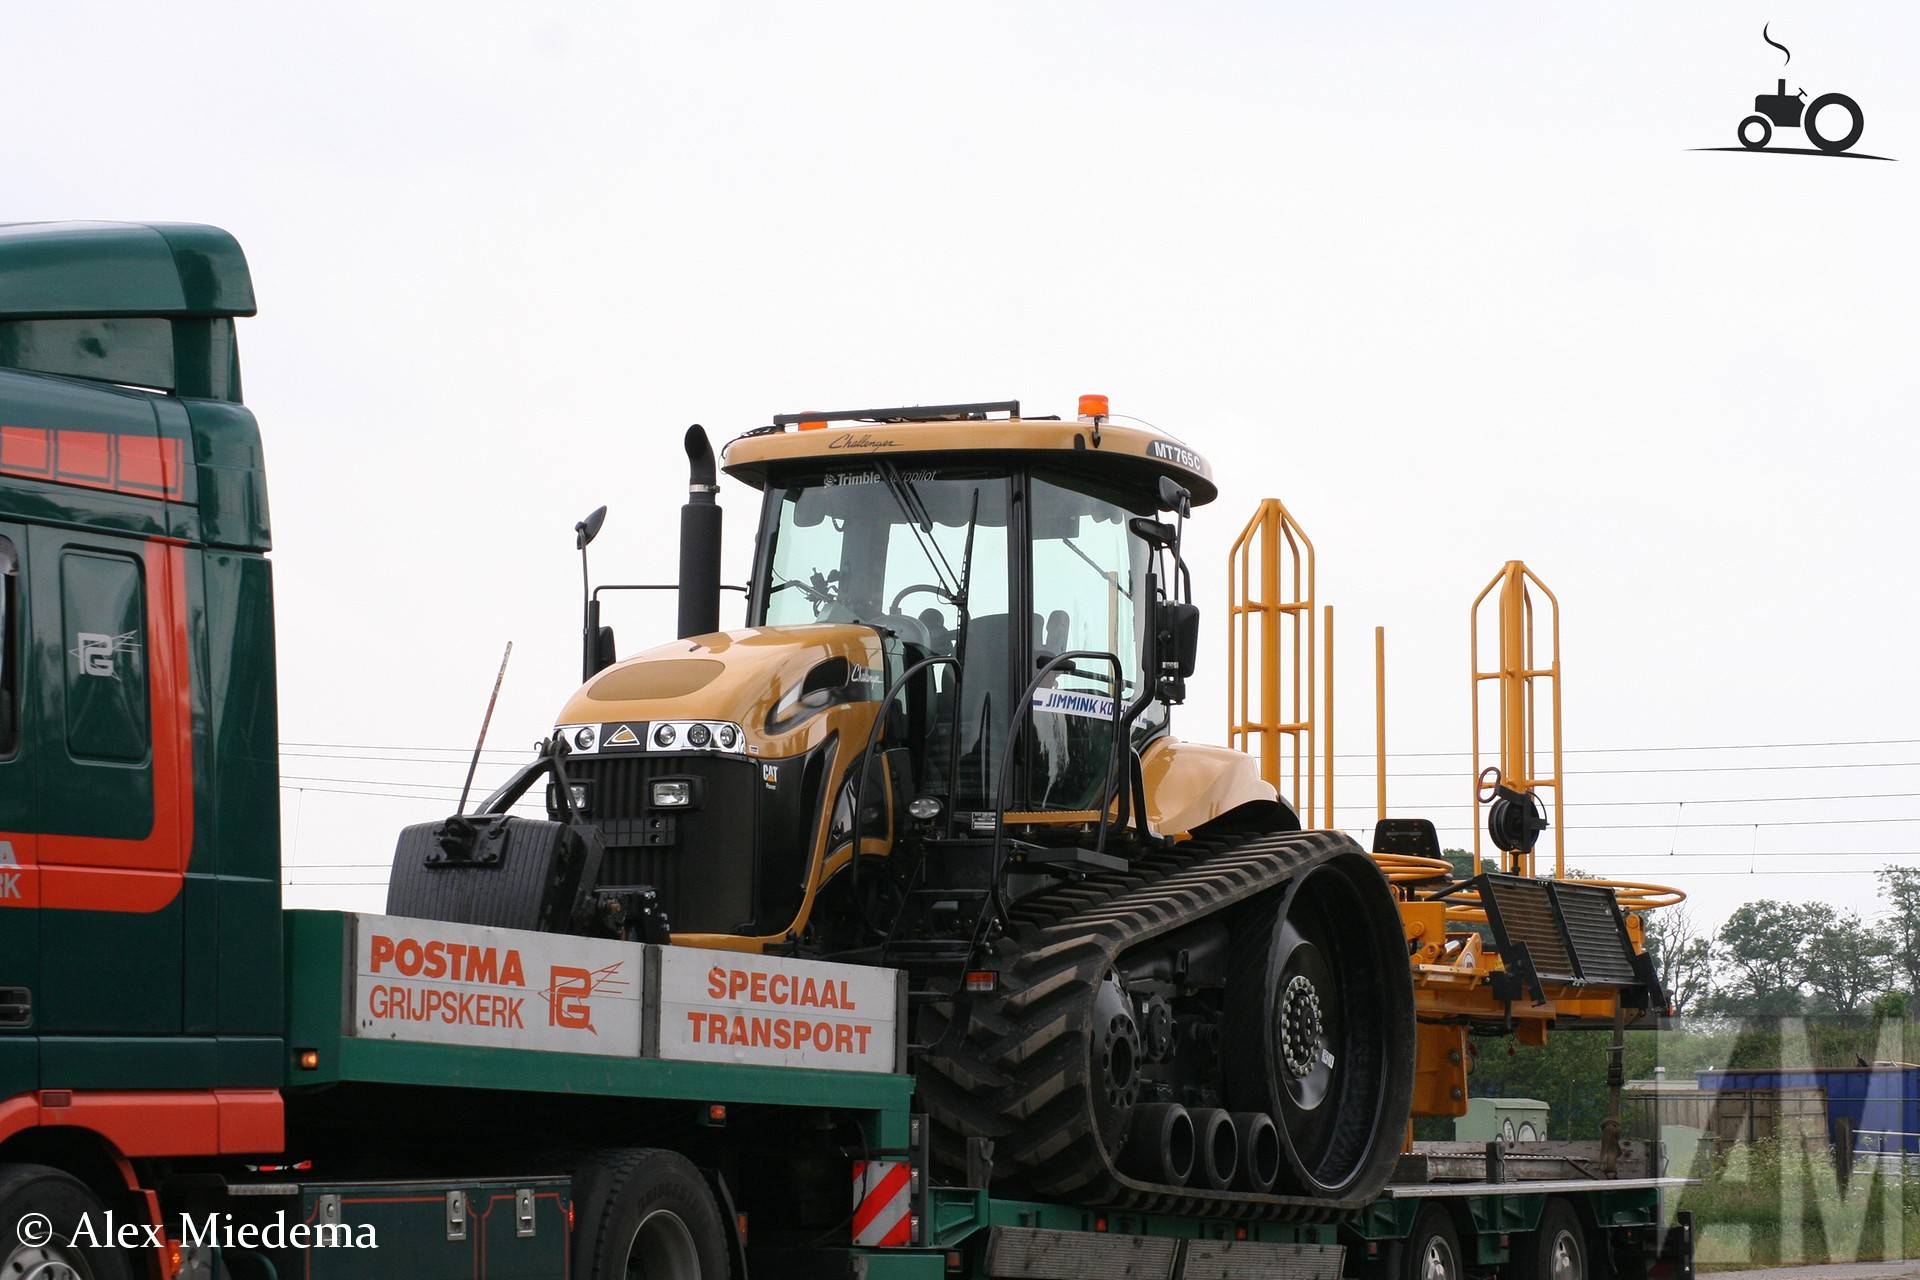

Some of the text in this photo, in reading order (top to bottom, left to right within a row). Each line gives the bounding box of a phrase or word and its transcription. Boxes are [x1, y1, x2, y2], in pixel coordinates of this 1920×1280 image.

[828, 433, 904, 453] Challenger
[1154, 441, 1200, 470] MT765C
[837, 471, 880, 486] Trimble
[1046, 693, 1096, 714] JIMMINK
[762, 764, 779, 783] CAT
[370, 935, 525, 986] POSTMA
[708, 966, 856, 1010] SPECIAAL
[369, 984, 525, 1029] GRIJPSKERK
[687, 1011, 872, 1055] TRANSPORT
